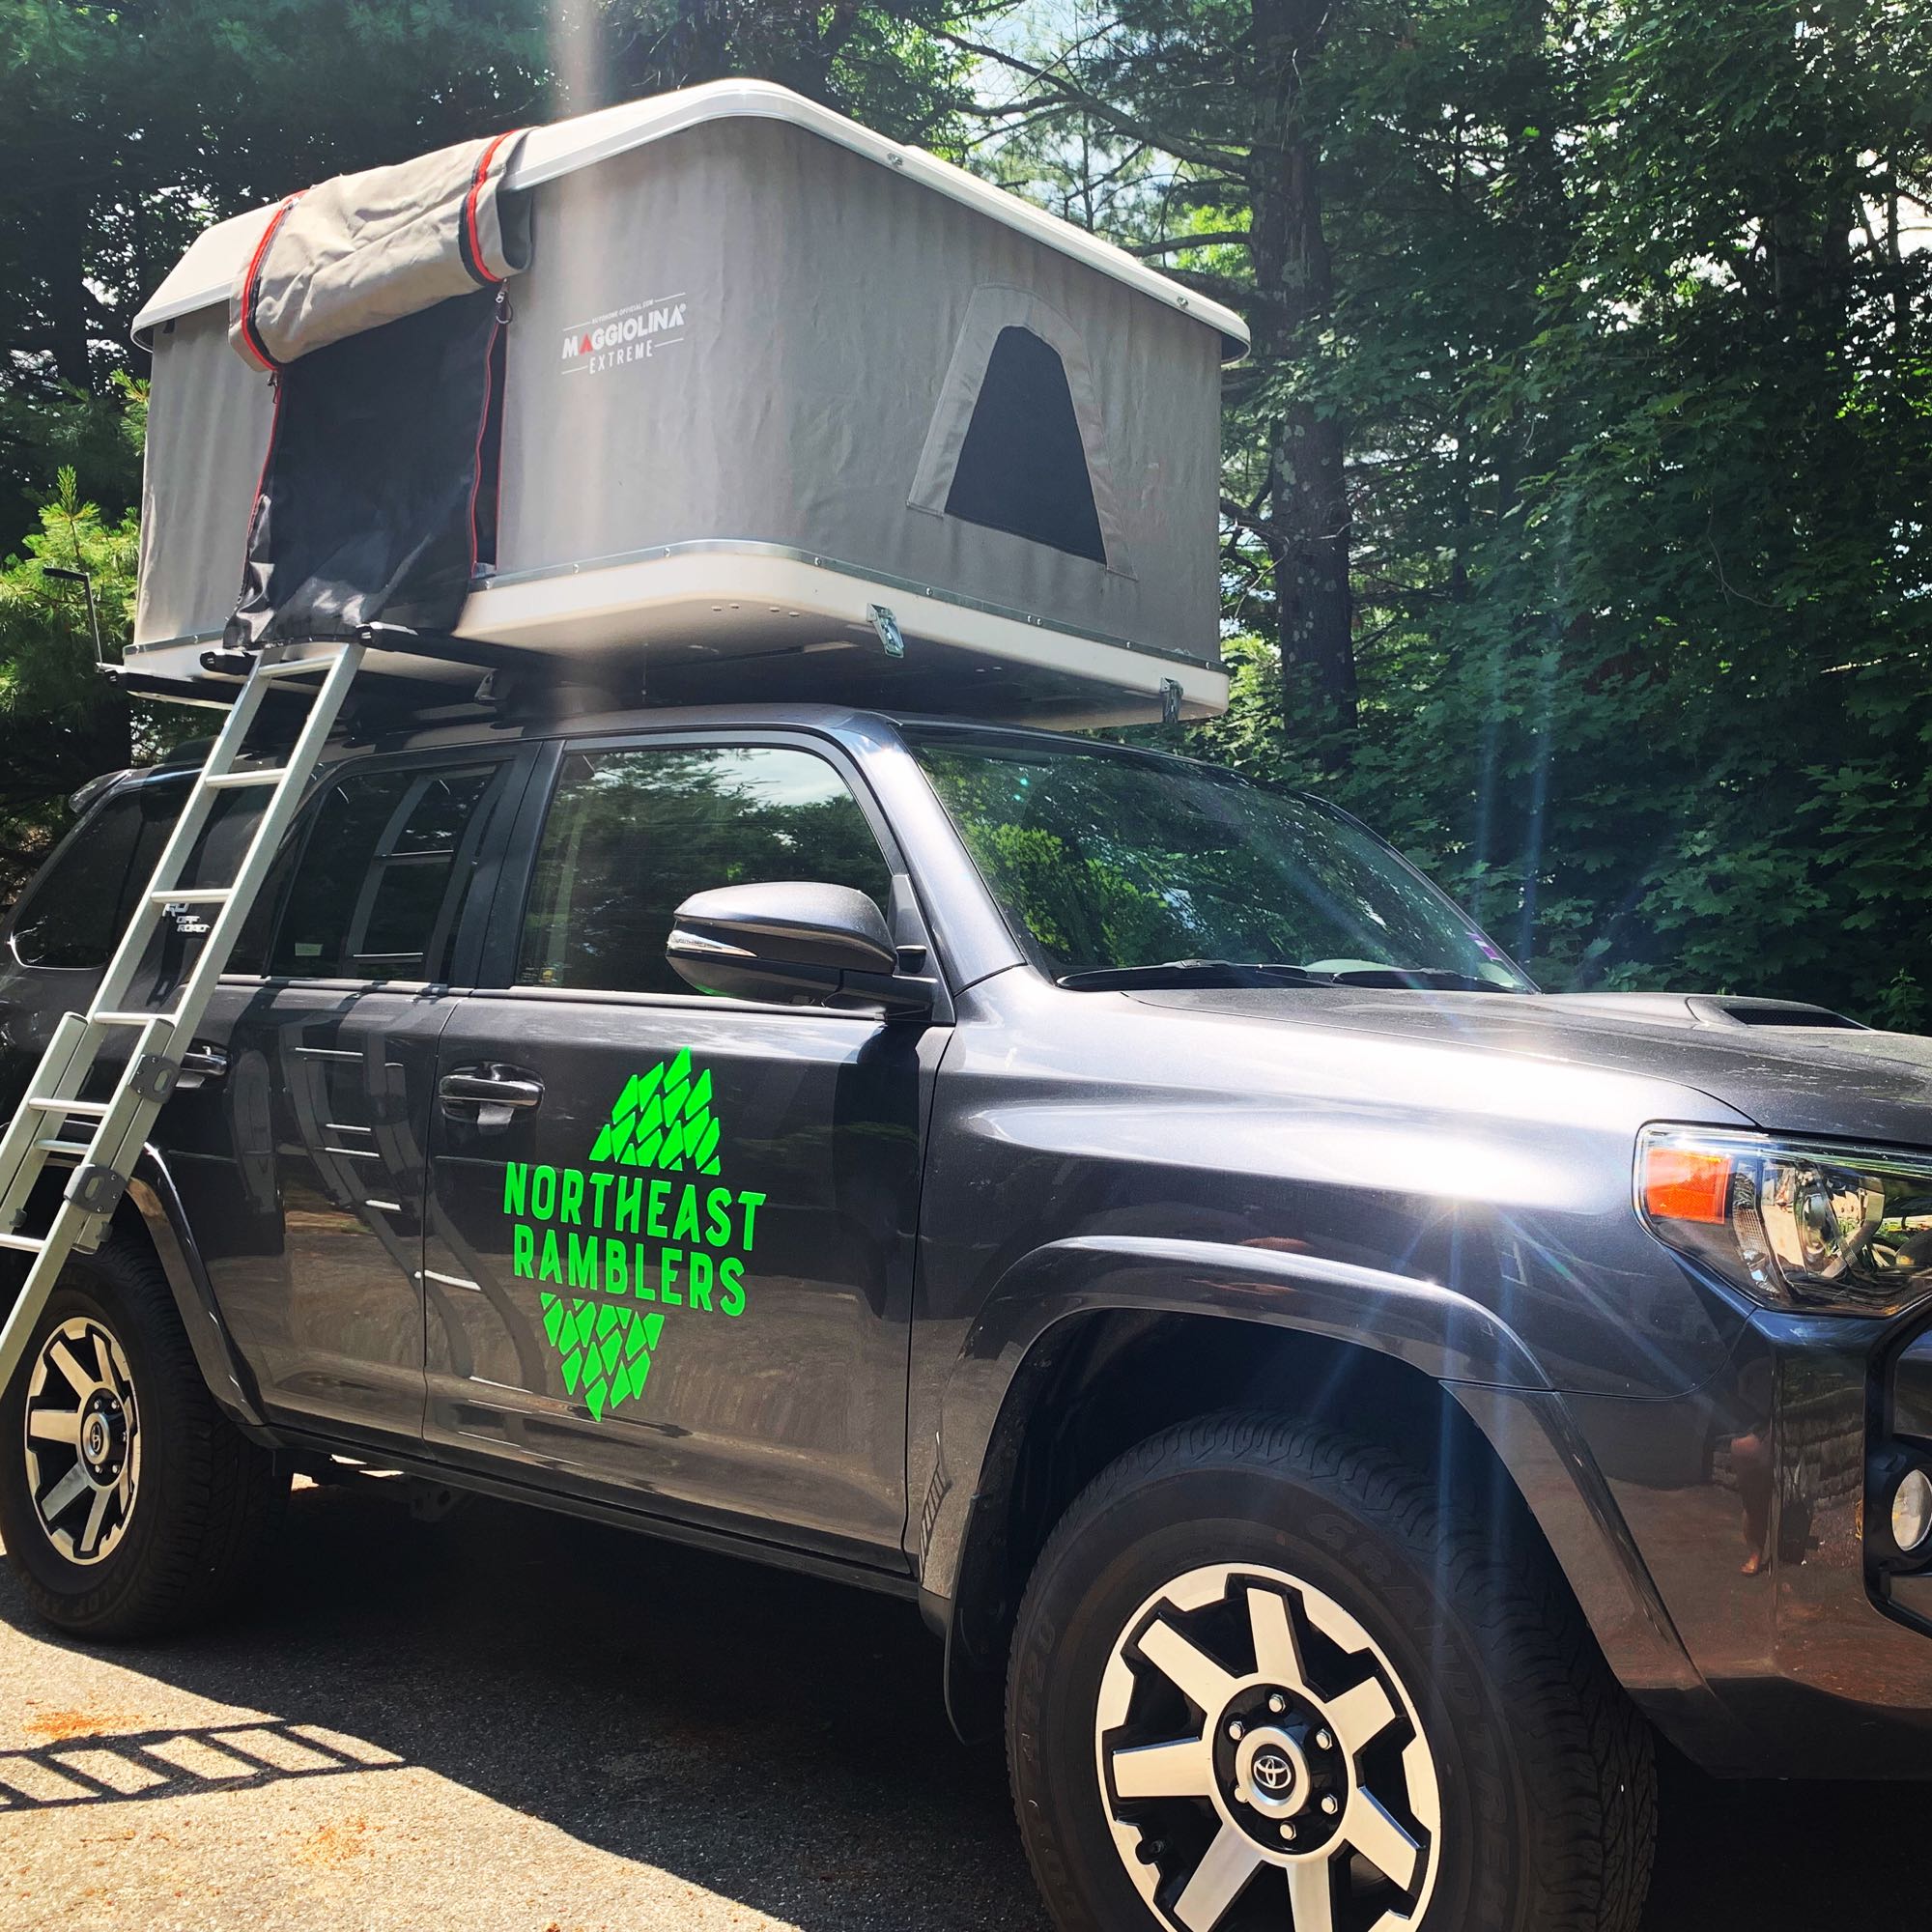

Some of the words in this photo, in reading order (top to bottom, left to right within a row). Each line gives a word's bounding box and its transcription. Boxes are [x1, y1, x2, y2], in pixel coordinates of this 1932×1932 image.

[561, 303, 685, 359] MAGGIOLINA
[589, 340, 653, 375] EXTREME
[176, 915, 201, 923] OFF
[177, 923, 211, 933] ROAD
[503, 1161, 767, 1251] NORTHEAST
[514, 1224, 746, 1317] RAMBLERS
